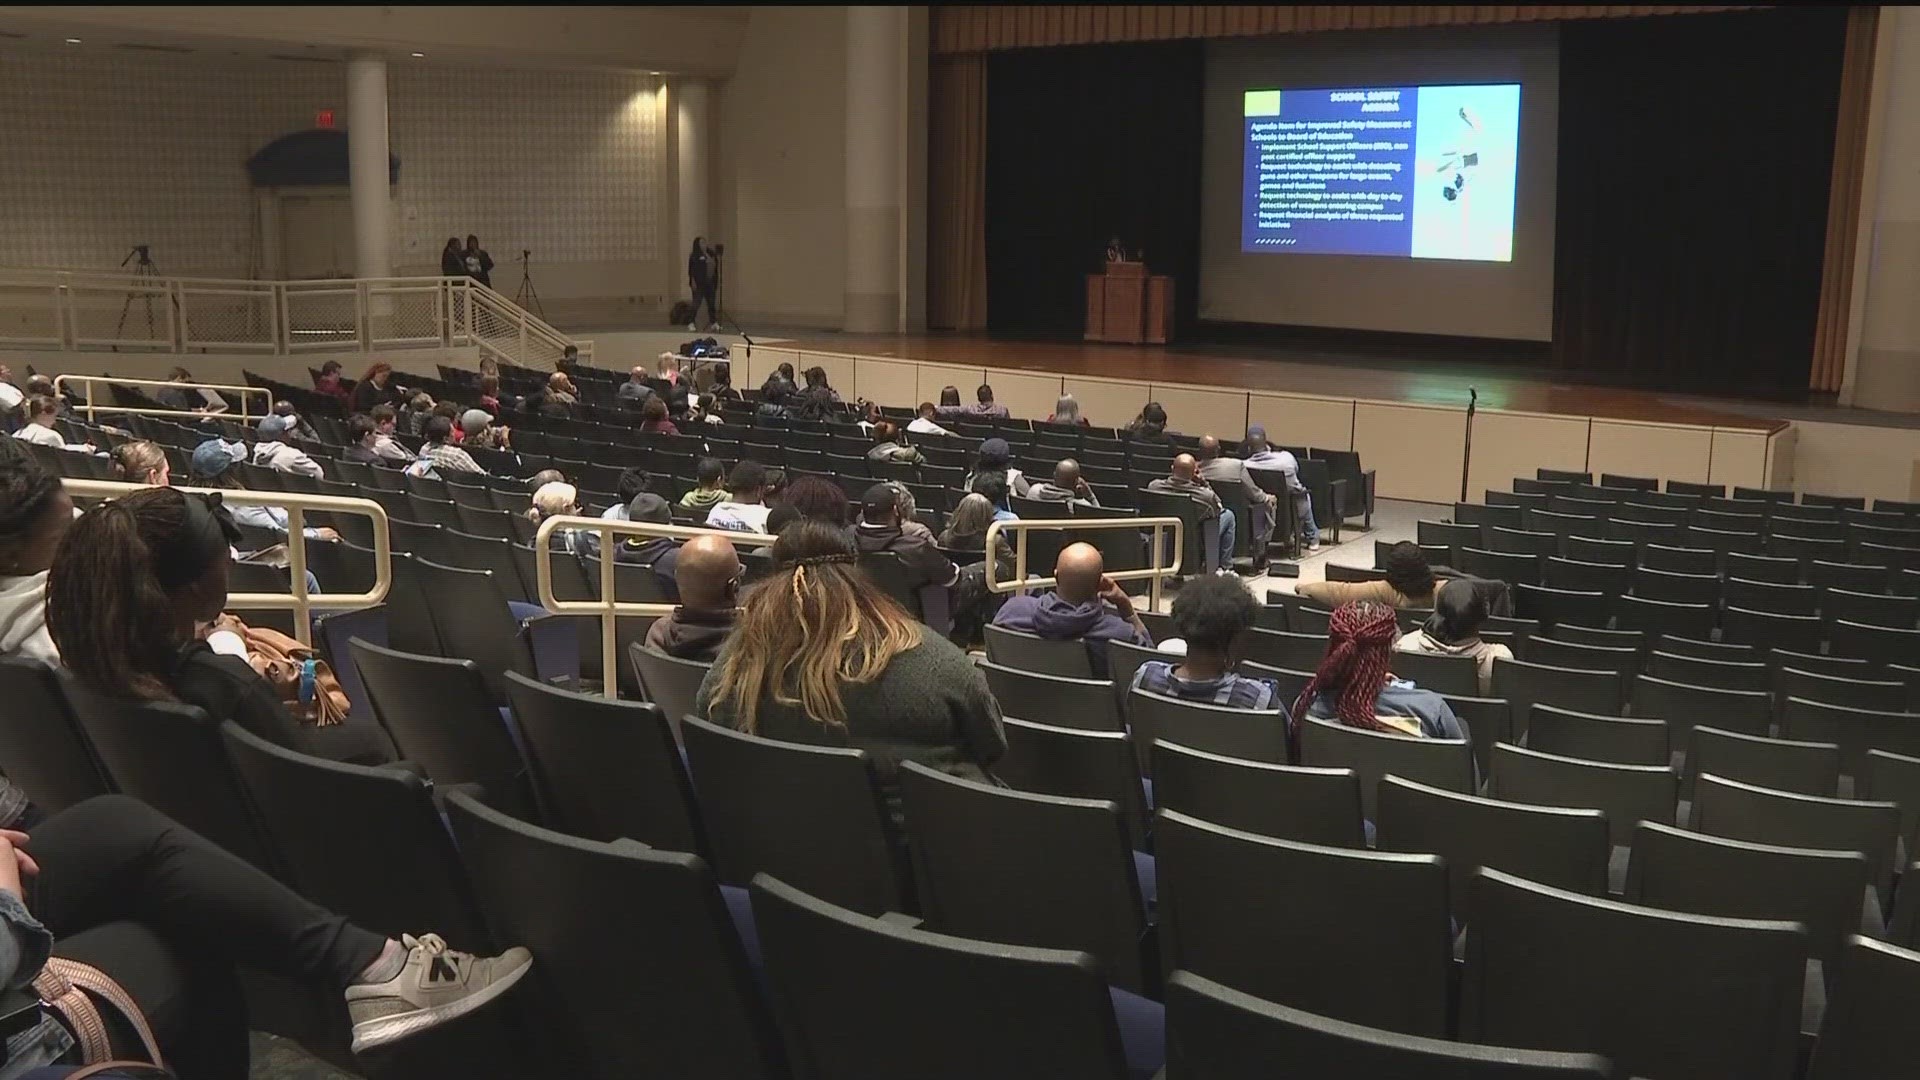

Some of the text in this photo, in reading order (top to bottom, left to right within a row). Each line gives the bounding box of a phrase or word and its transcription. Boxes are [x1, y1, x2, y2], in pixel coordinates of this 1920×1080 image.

[1251, 123, 1277, 131] Agenda
[1343, 120, 1365, 130] Safety
[1251, 133, 1277, 141] Schools
[1318, 132, 1353, 140] Education
[1261, 163, 1286, 171] Request
[1287, 163, 1323, 171] technology
[1328, 203, 1356, 211] entering
[1315, 212, 1341, 221] analysis
[429, 957, 459, 982] N
